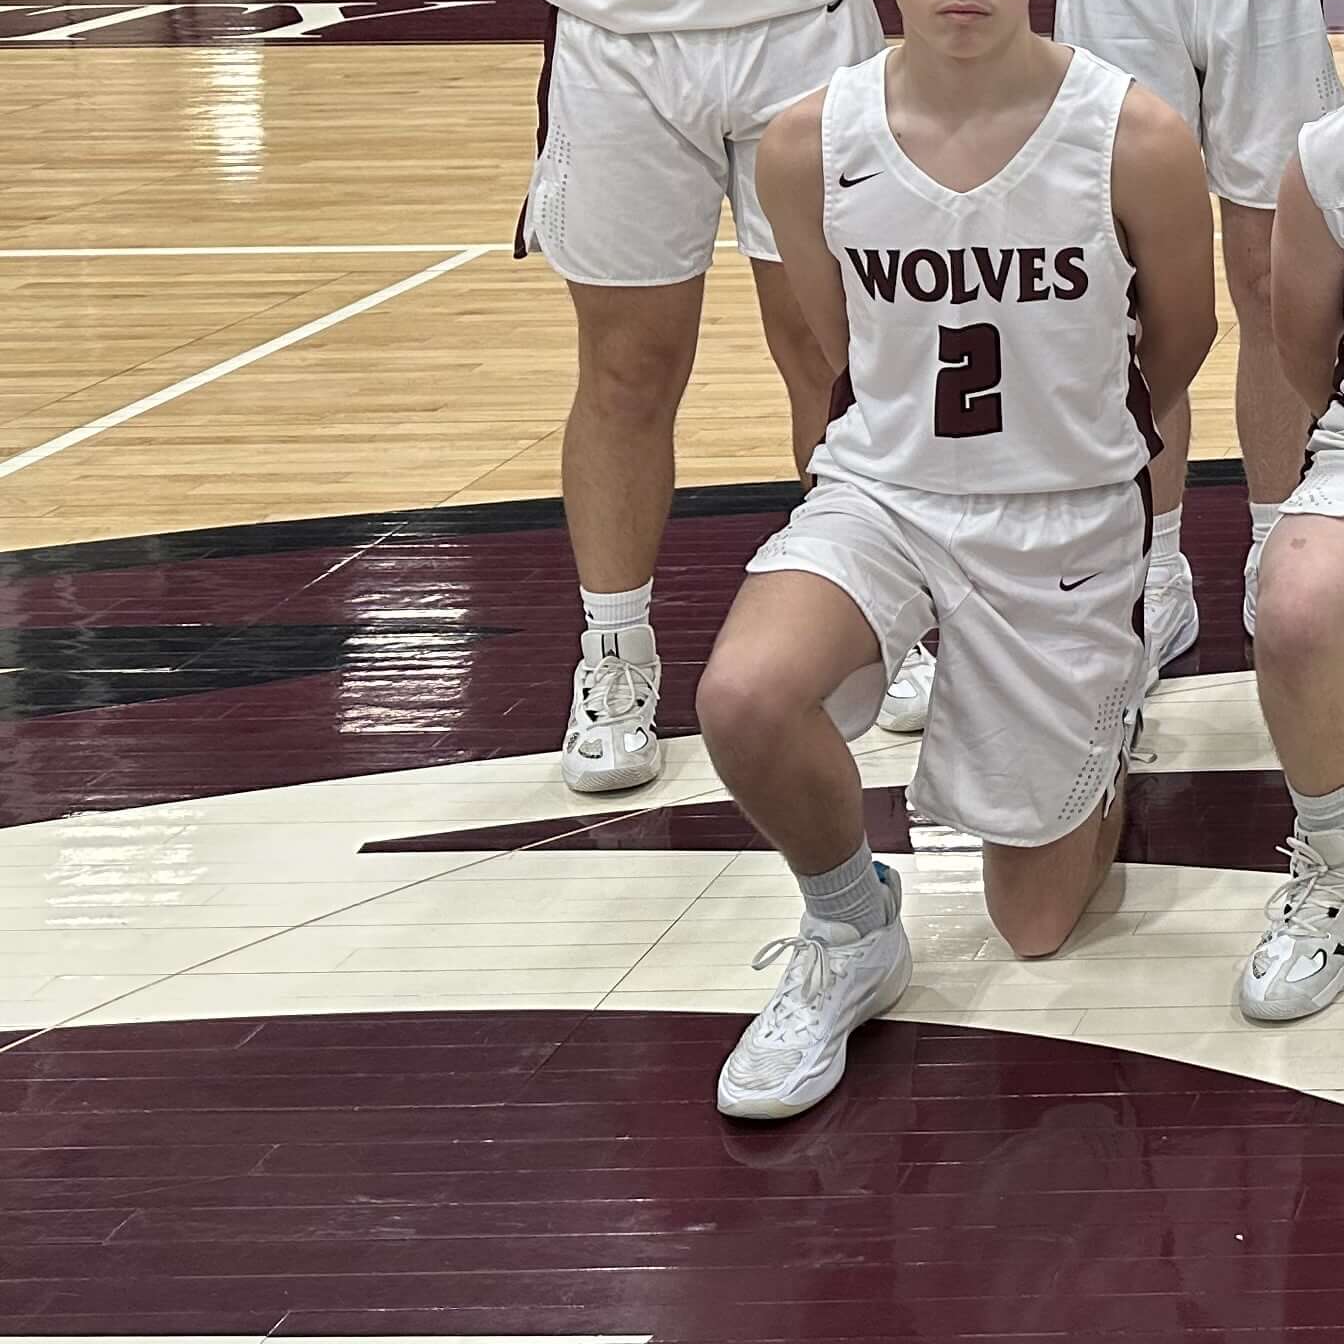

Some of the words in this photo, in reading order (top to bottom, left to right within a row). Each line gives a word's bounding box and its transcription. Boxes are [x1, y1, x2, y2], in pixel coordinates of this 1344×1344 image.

[0, 0, 497, 39] TY
[843, 246, 1089, 306] WOLVES
[934, 322, 1004, 439] 2
